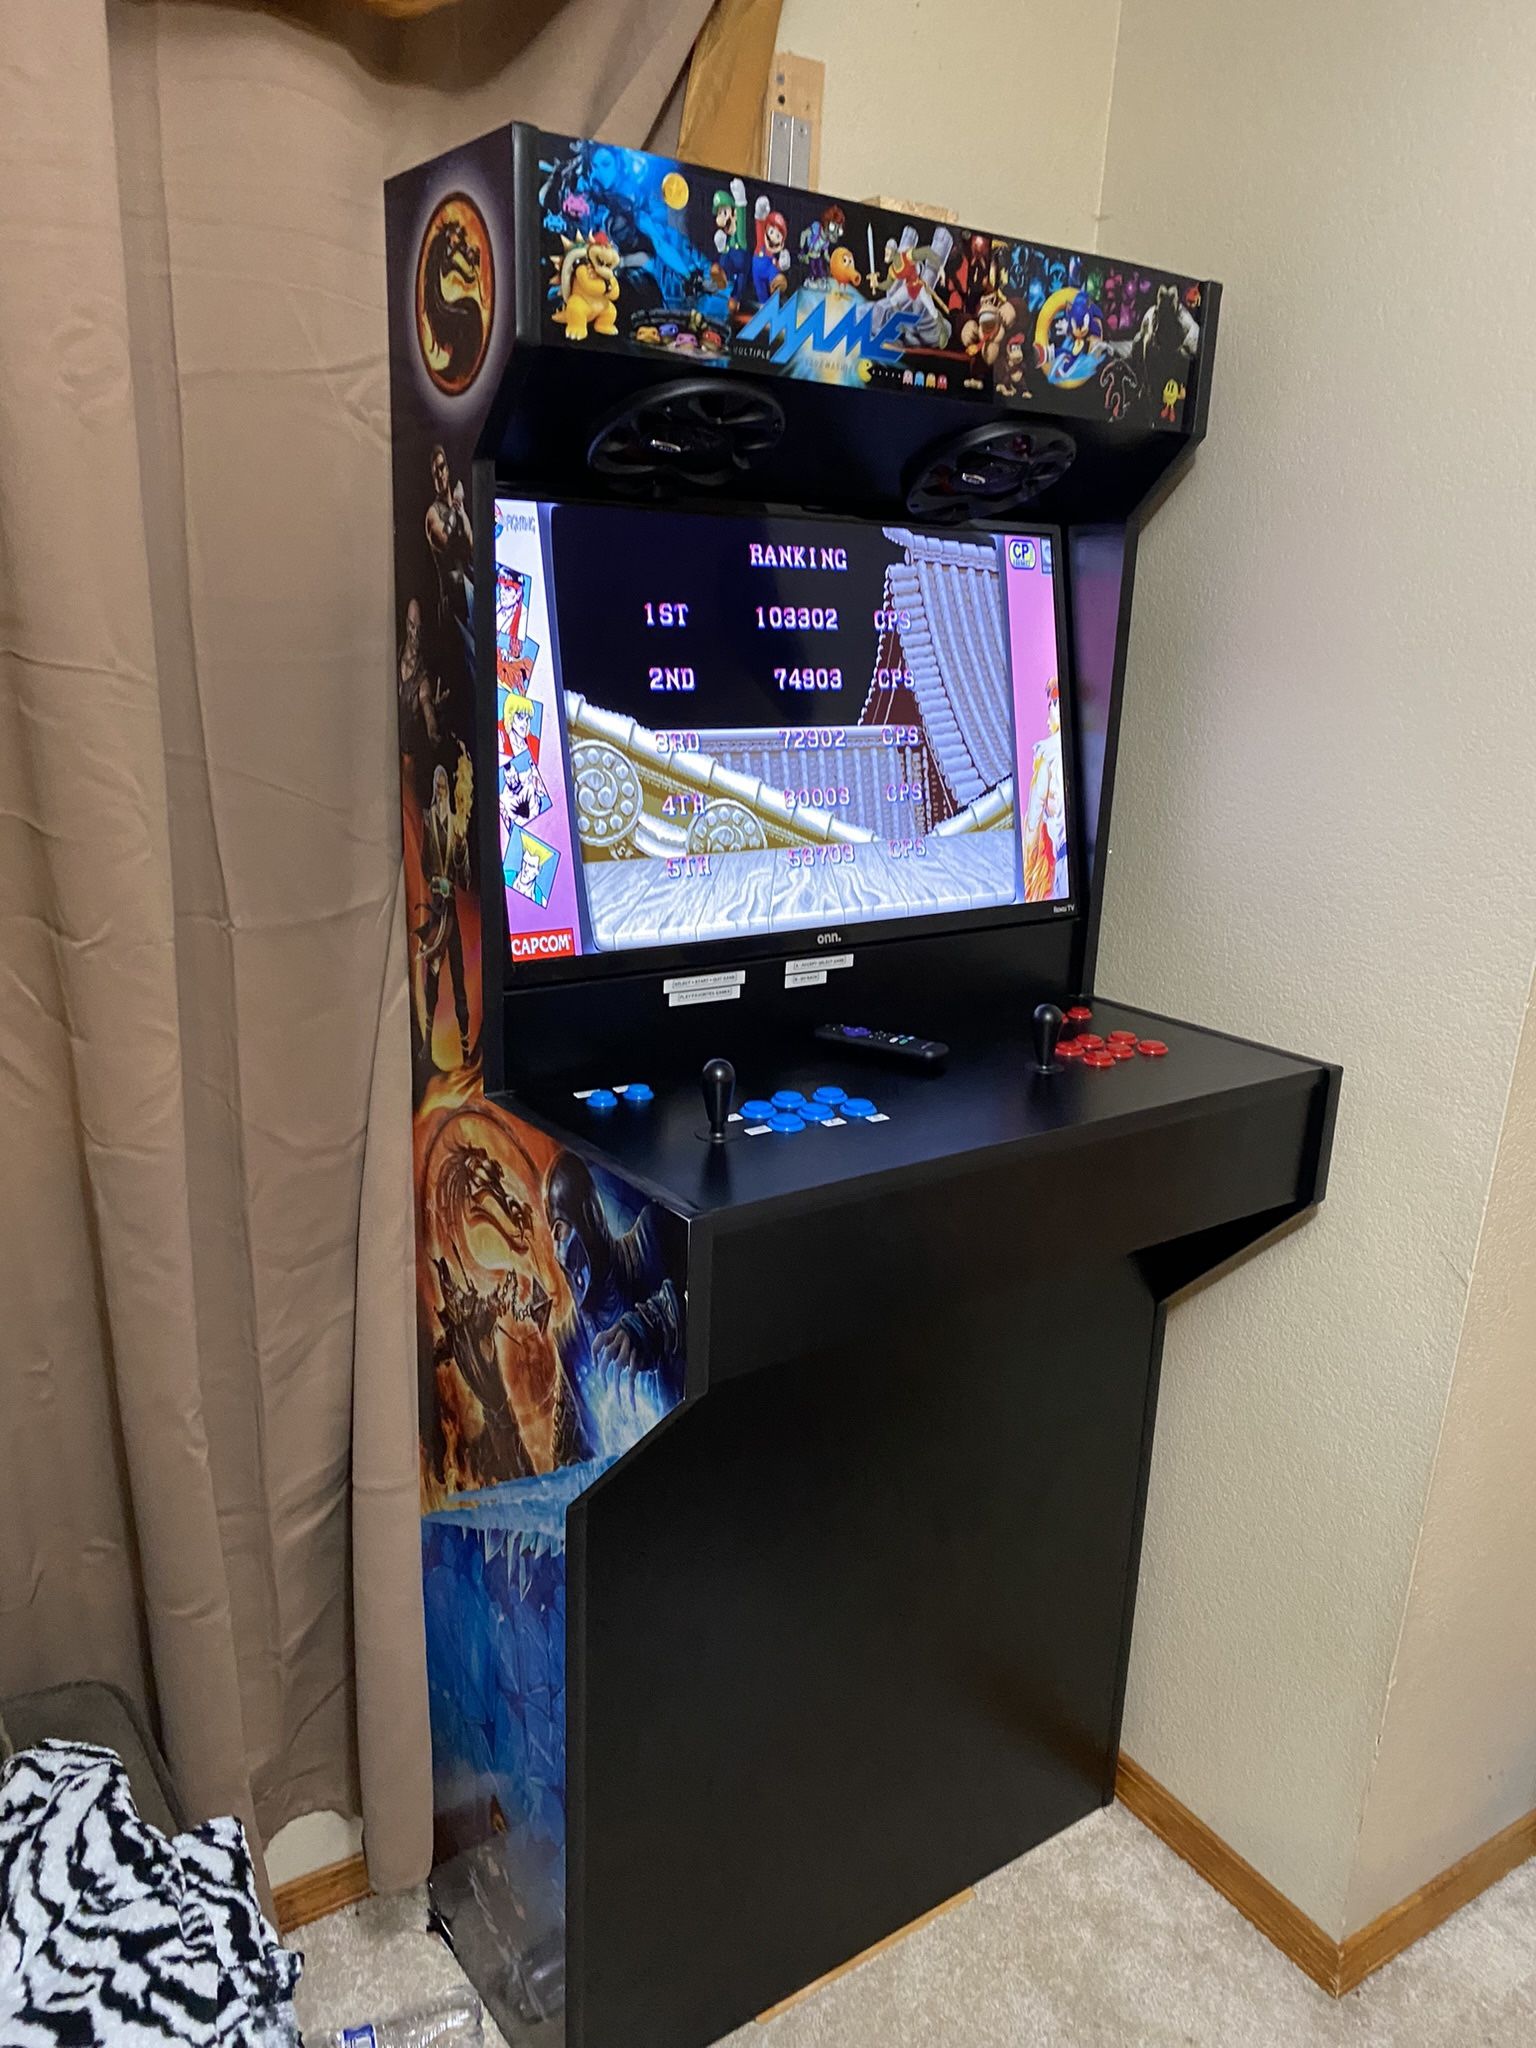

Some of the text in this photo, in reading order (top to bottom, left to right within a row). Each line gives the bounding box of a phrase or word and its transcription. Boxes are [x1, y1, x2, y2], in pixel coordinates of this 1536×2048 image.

[736, 289, 921, 363] MAME
[749, 544, 847, 571] RANKING
[644, 603, 912, 632] 1ST 103302 CPS
[648, 667, 696, 692] 2ND
[877, 668, 915, 690] CPS
[655, 727, 919, 752] 3RD 72902 CPS
[662, 794, 706, 816] 4TH
[886, 783, 923, 802] CPS
[666, 839, 927, 878] 5TH 58703 CPS
[1067, 903, 1075, 912] TV
[511, 934, 570, 955] CAPCOM
[817, 932, 842, 945] onn.
